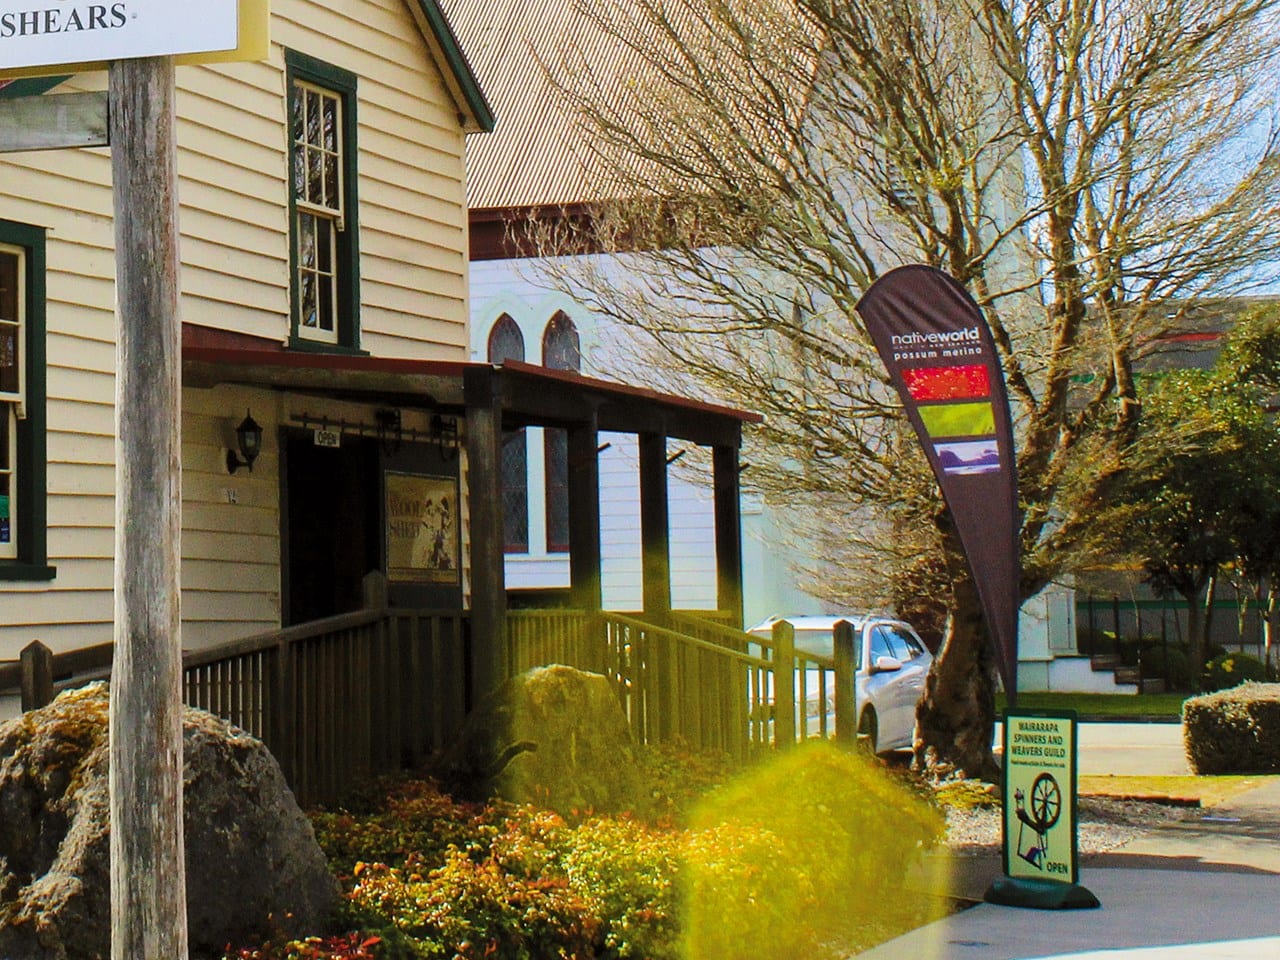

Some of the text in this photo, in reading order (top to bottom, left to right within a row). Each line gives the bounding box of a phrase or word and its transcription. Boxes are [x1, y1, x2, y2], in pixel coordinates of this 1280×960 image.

[0, 2, 127, 38] SHEARS
[892, 327, 979, 344] nativeworld
[894, 347, 982, 361] possum merino
[1018, 722, 1059, 733] WAIRARAPA
[1013, 733, 1063, 745] SPINNERS AND
[1011, 745, 1066, 758] WEAVERS GUILD
[1046, 861, 1067, 873] OPEN
